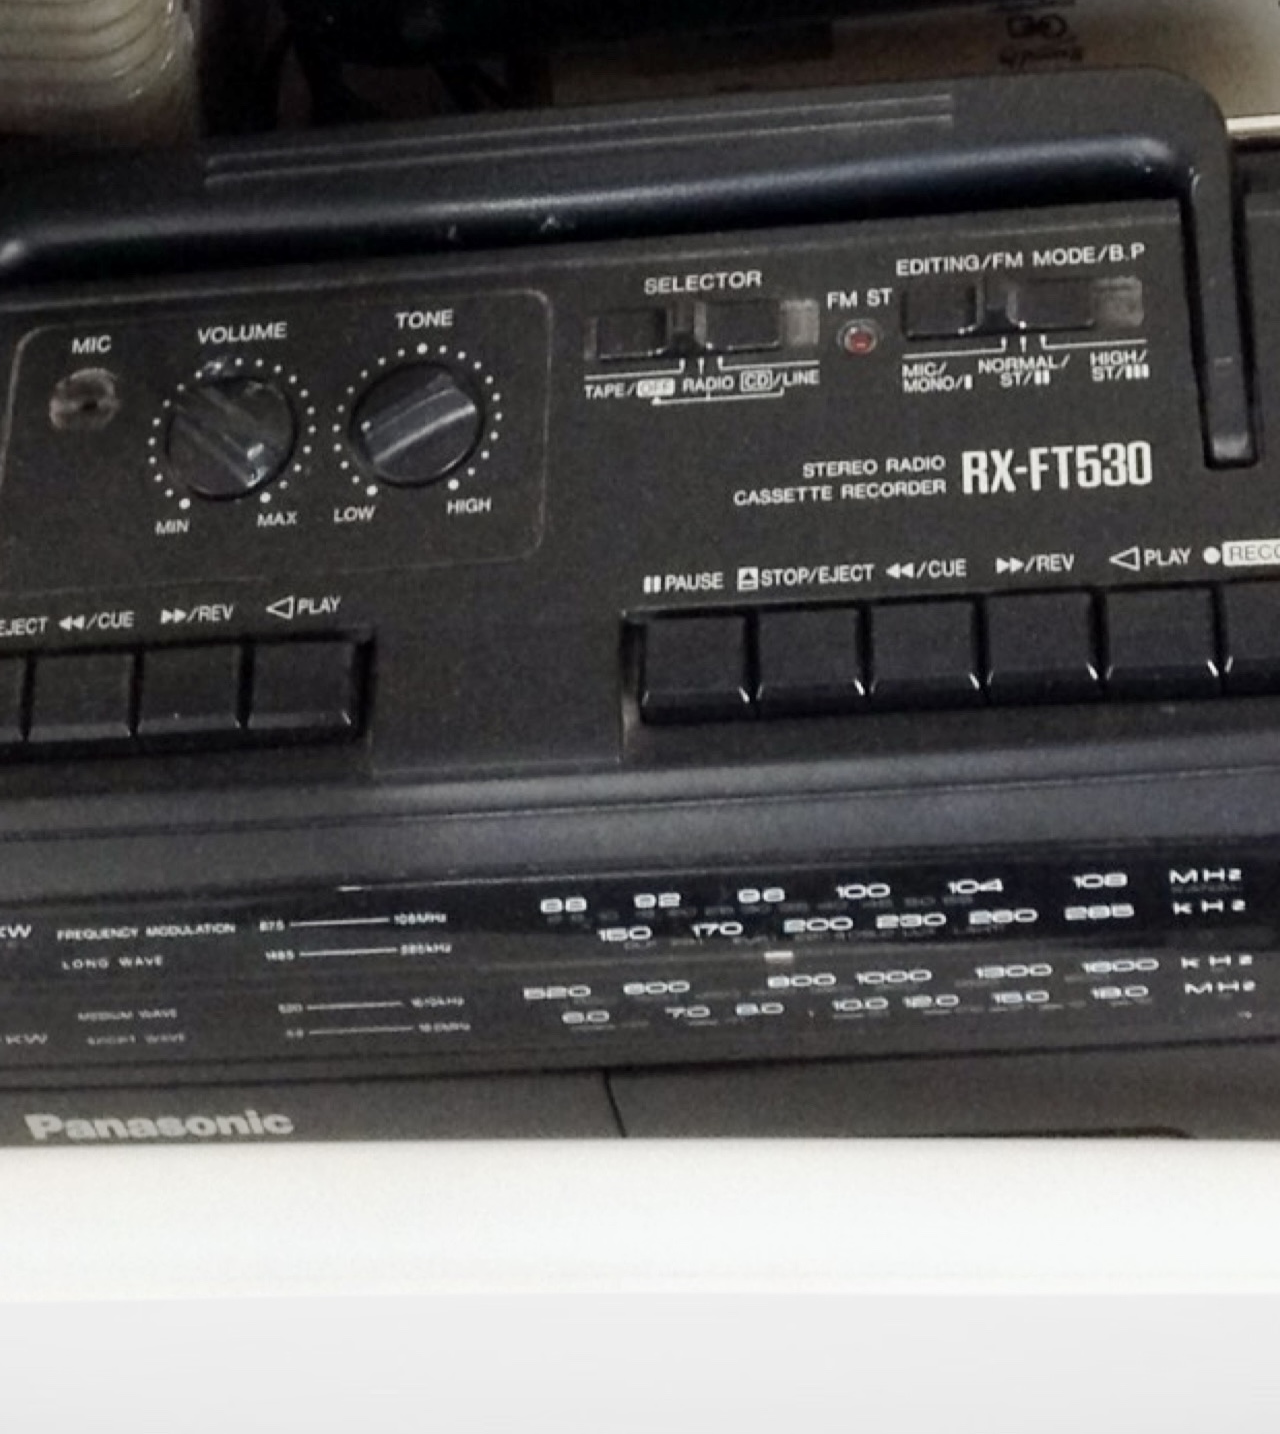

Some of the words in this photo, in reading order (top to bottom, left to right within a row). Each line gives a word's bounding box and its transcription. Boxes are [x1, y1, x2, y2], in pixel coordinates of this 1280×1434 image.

[644, 270, 762, 294] SELECTOR
[827, 291, 858, 309] FM
[866, 288, 892, 306] ST
[395, 309, 454, 330] TONE
[72, 335, 111, 354] MIC
[197, 322, 287, 344] VOLUME
[683, 377, 733, 392] RADIO
[803, 459, 878, 479] STEREO
[885, 455, 946, 474] RADIO
[961, 440, 1153, 495] RX-FT530
[733, 485, 832, 506] CASSETTE
[840, 479, 946, 500] RECORDER
[333, 505, 376, 523] LOW
[447, 497, 491, 514] HIGH
[155, 519, 188, 535] MIN
[257, 511, 297, 527] MAX
[664, 572, 723, 592] PAUSE
[760, 564, 875, 587] STOP/EJECT
[1144, 547, 1191, 566] PLAY
[297, 595, 342, 616] PLAY
[835, 883, 891, 899] 100
[948, 878, 1004, 895] 104
[1073, 873, 1128, 888] 108
[57, 927, 139, 941] FREQUENCY
[146, 923, 236, 937] MODULATION
[693, 921, 744, 939] 170
[62, 957, 110, 971] LONG
[119, 955, 164, 968] WAVE
[24, 1108, 294, 1140] Panasonic
